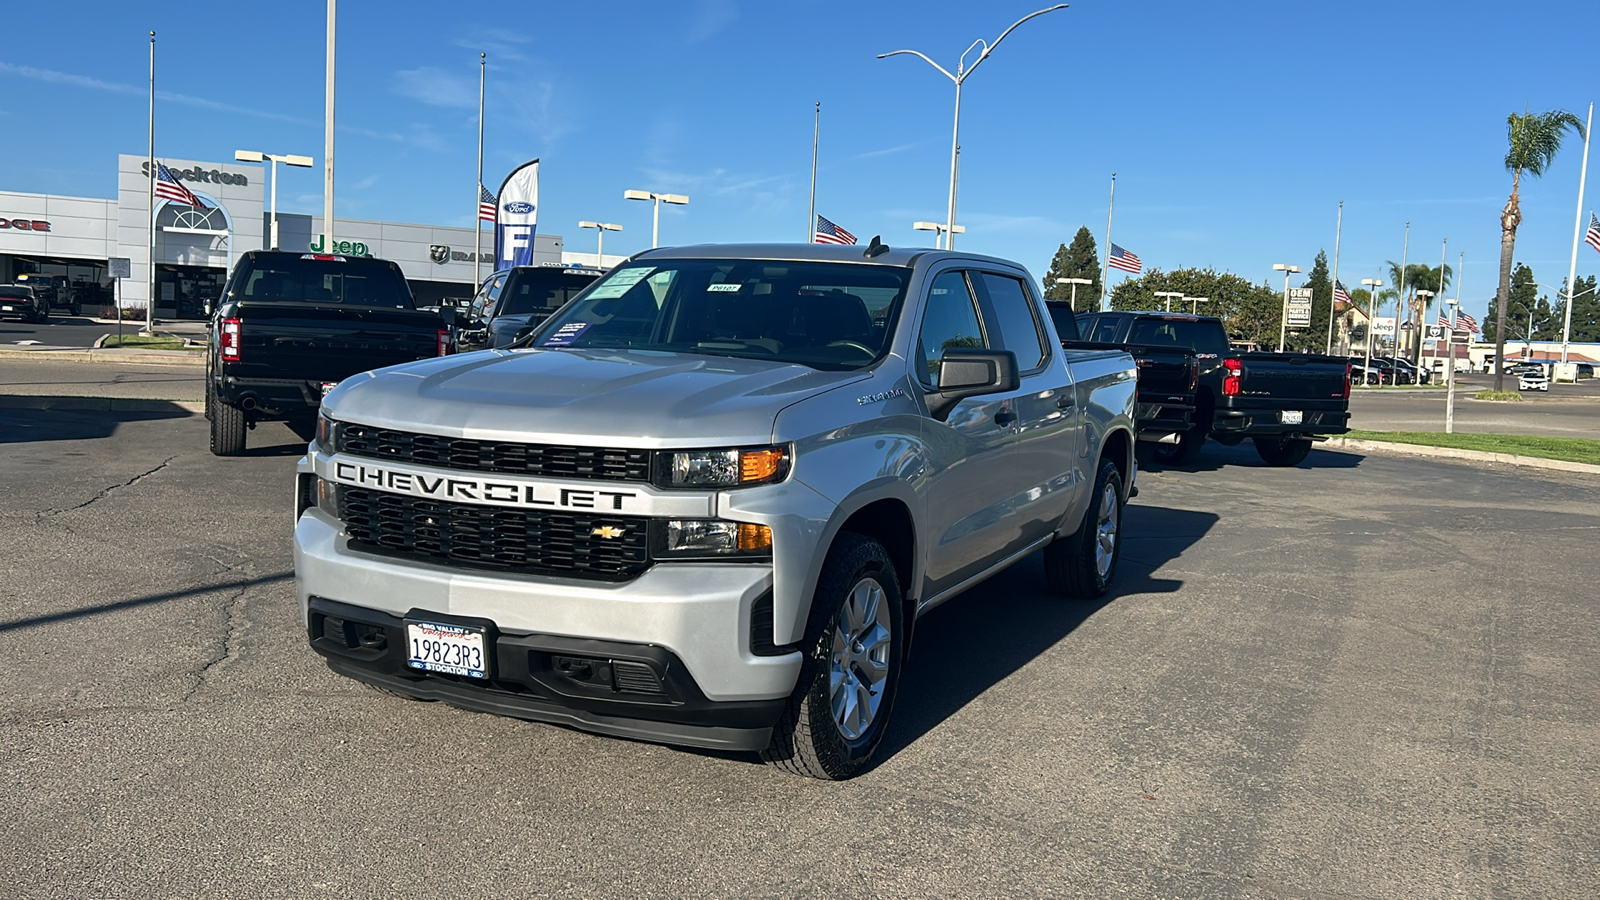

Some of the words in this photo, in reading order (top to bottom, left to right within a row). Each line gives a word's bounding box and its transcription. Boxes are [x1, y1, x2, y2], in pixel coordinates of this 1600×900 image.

[142, 161, 247, 186] Sockton
[508, 203, 530, 213] Ford
[1290, 289, 1311, 298] OEM
[1373, 323, 1394, 331] Jeep
[334, 462, 636, 510] CHEVROLET
[422, 622, 436, 630] BIG
[436, 625, 464, 634] VALLEY
[413, 638, 481, 668] 19823R3
[425, 662, 468, 676] STOCKTON
